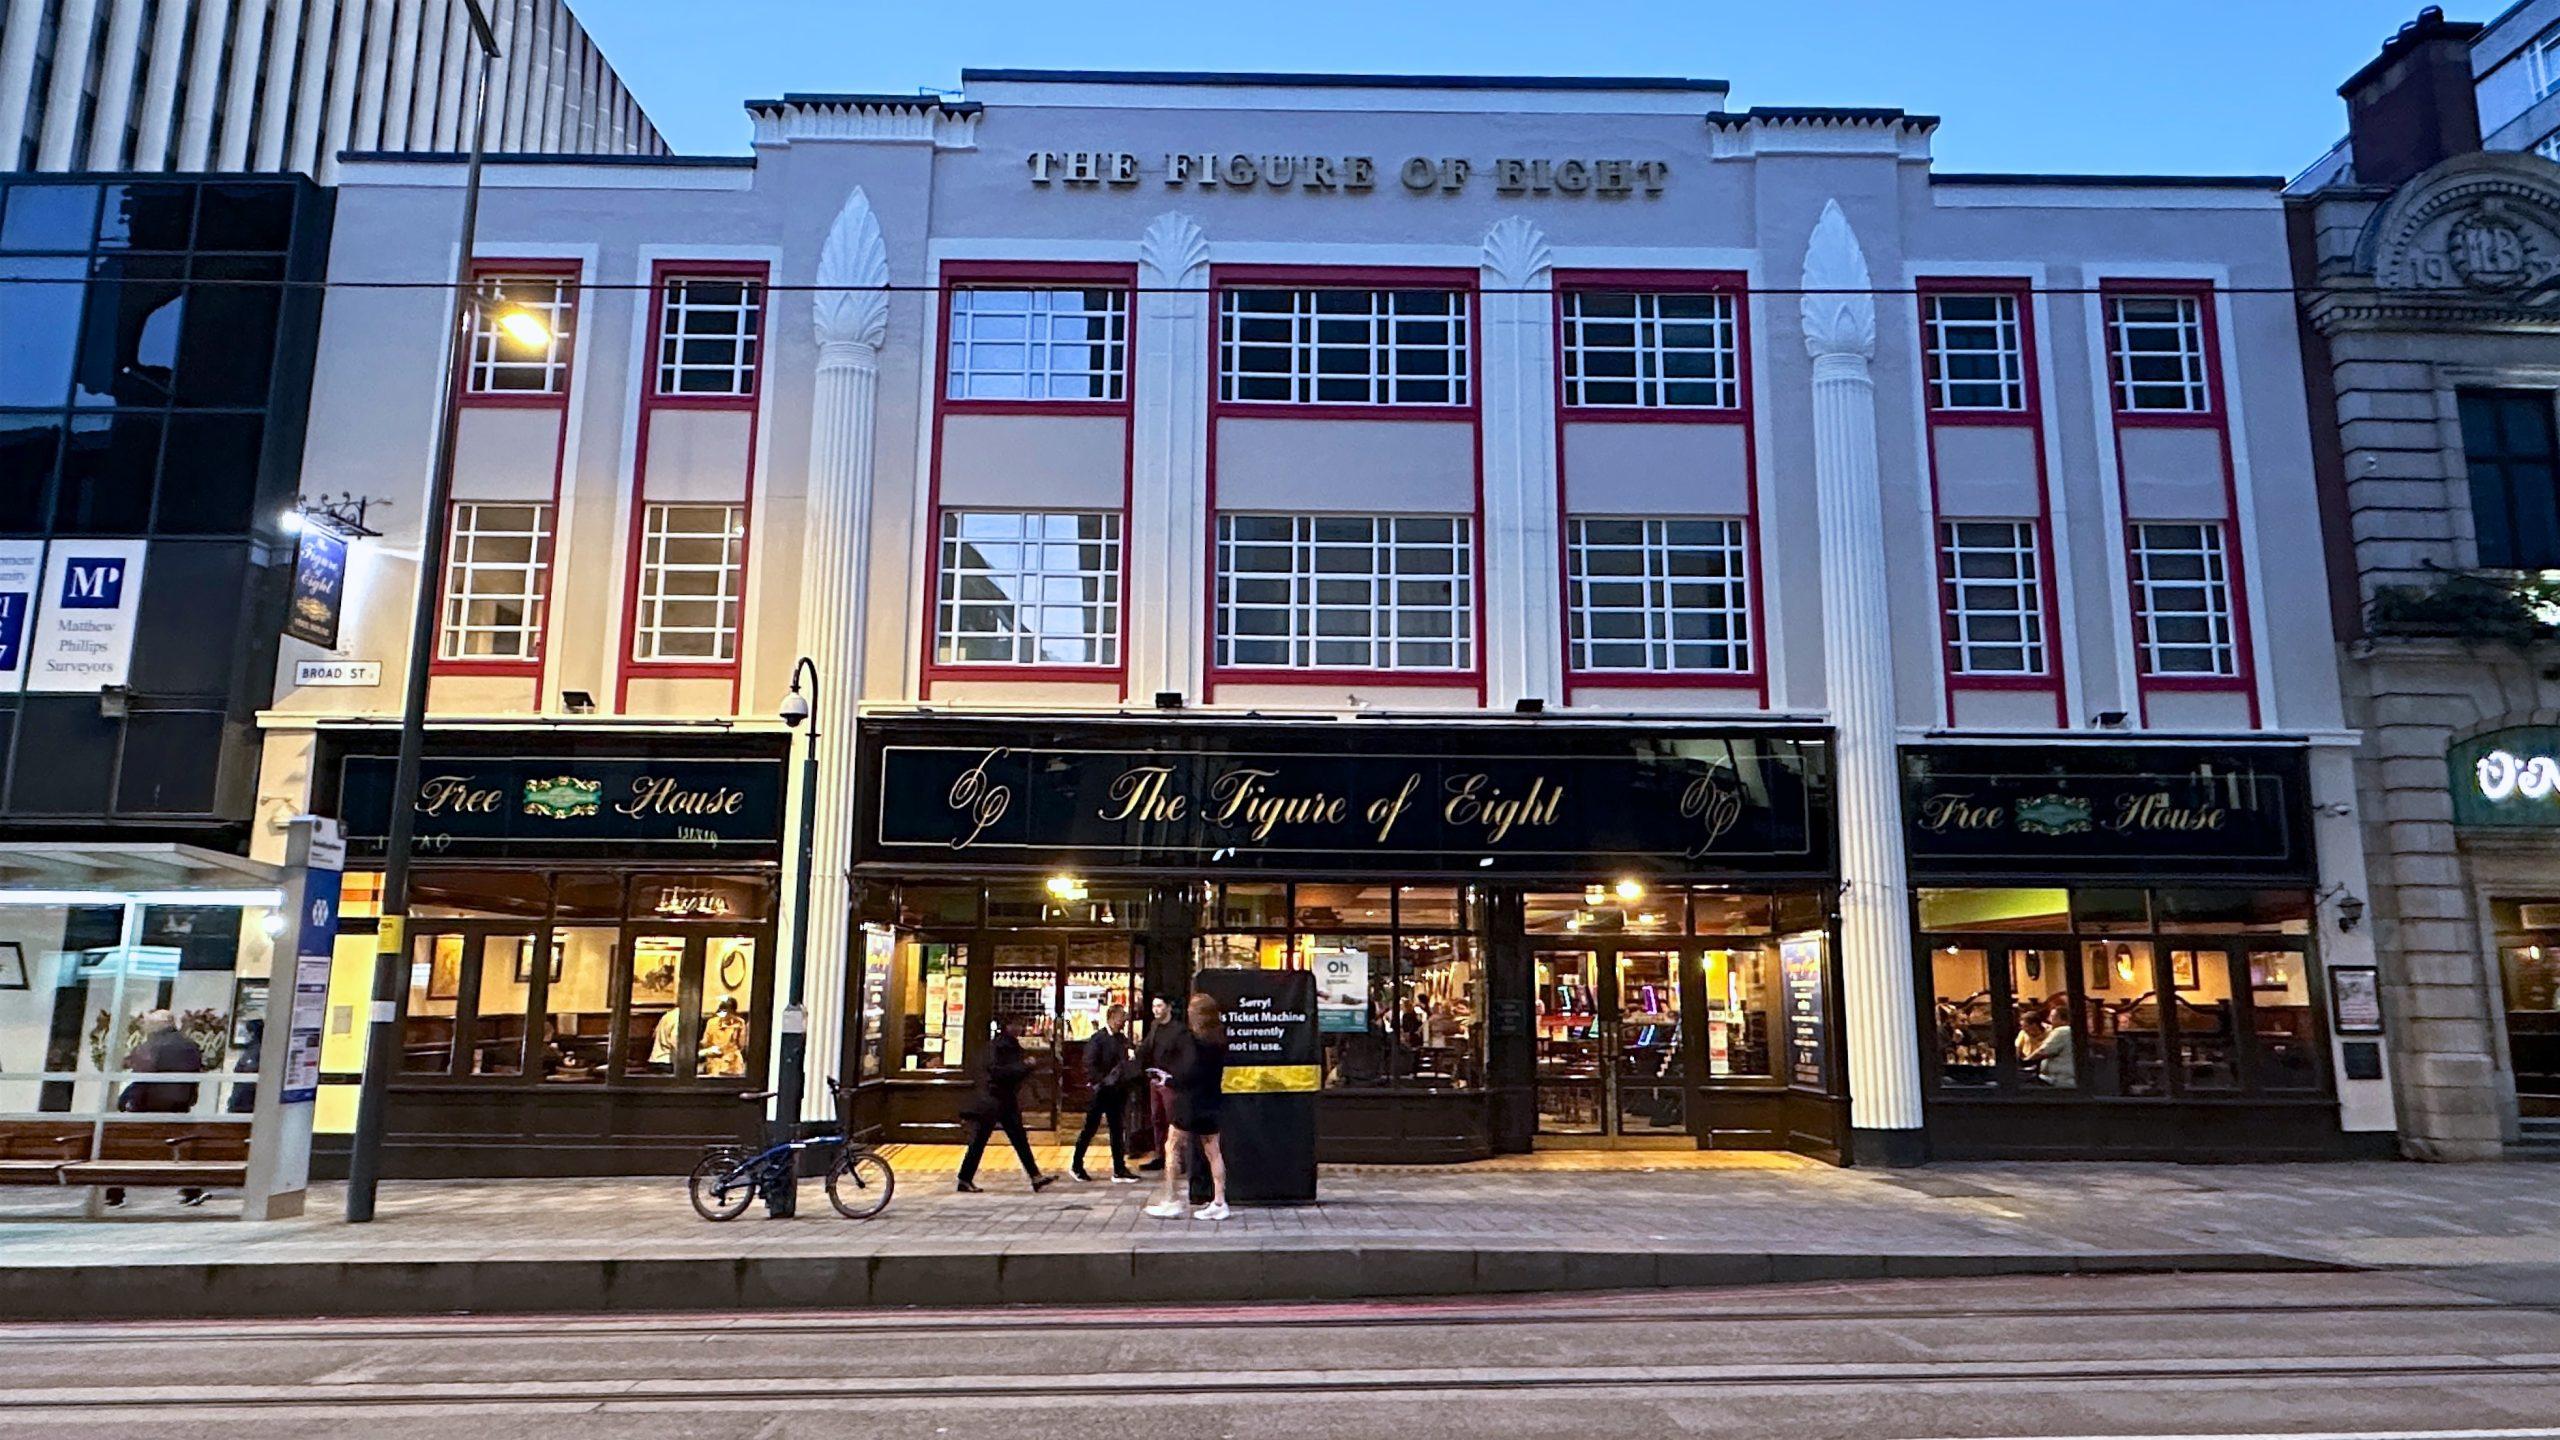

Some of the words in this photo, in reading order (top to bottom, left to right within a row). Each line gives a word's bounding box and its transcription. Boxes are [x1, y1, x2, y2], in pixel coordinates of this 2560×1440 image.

[1026, 152, 1140, 185] THE
[1164, 152, 1375, 190] FIGURE
[1401, 155, 1471, 191] OF
[1495, 157, 1669, 193] EIGHT
[58, 619, 115, 632] Matthew
[58, 639, 108, 655] Phillips
[45, 659, 114, 674] Surveyors
[302, 667, 342, 679] BROAD
[350, 668, 366, 679] ST
[413, 775, 503, 818] Free
[614, 775, 744, 820] House
[1098, 764, 1187, 822] The
[1200, 768, 1347, 842] Figure
[1366, 772, 1421, 843] of
[1444, 772, 1564, 844] Eight
[1917, 792, 2004, 835] Free
[2099, 792, 2226, 836] House
[1228, 1011, 1260, 1022] Ticket
[1261, 1011, 1306, 1022] Machine
[1226, 1025, 1236, 1037] is
[1237, 1025, 1285, 1039] currently
[1228, 1041, 1247, 1051] not
[1249, 1040, 1259, 1051] in
[1261, 1042, 1283, 1051] use.
